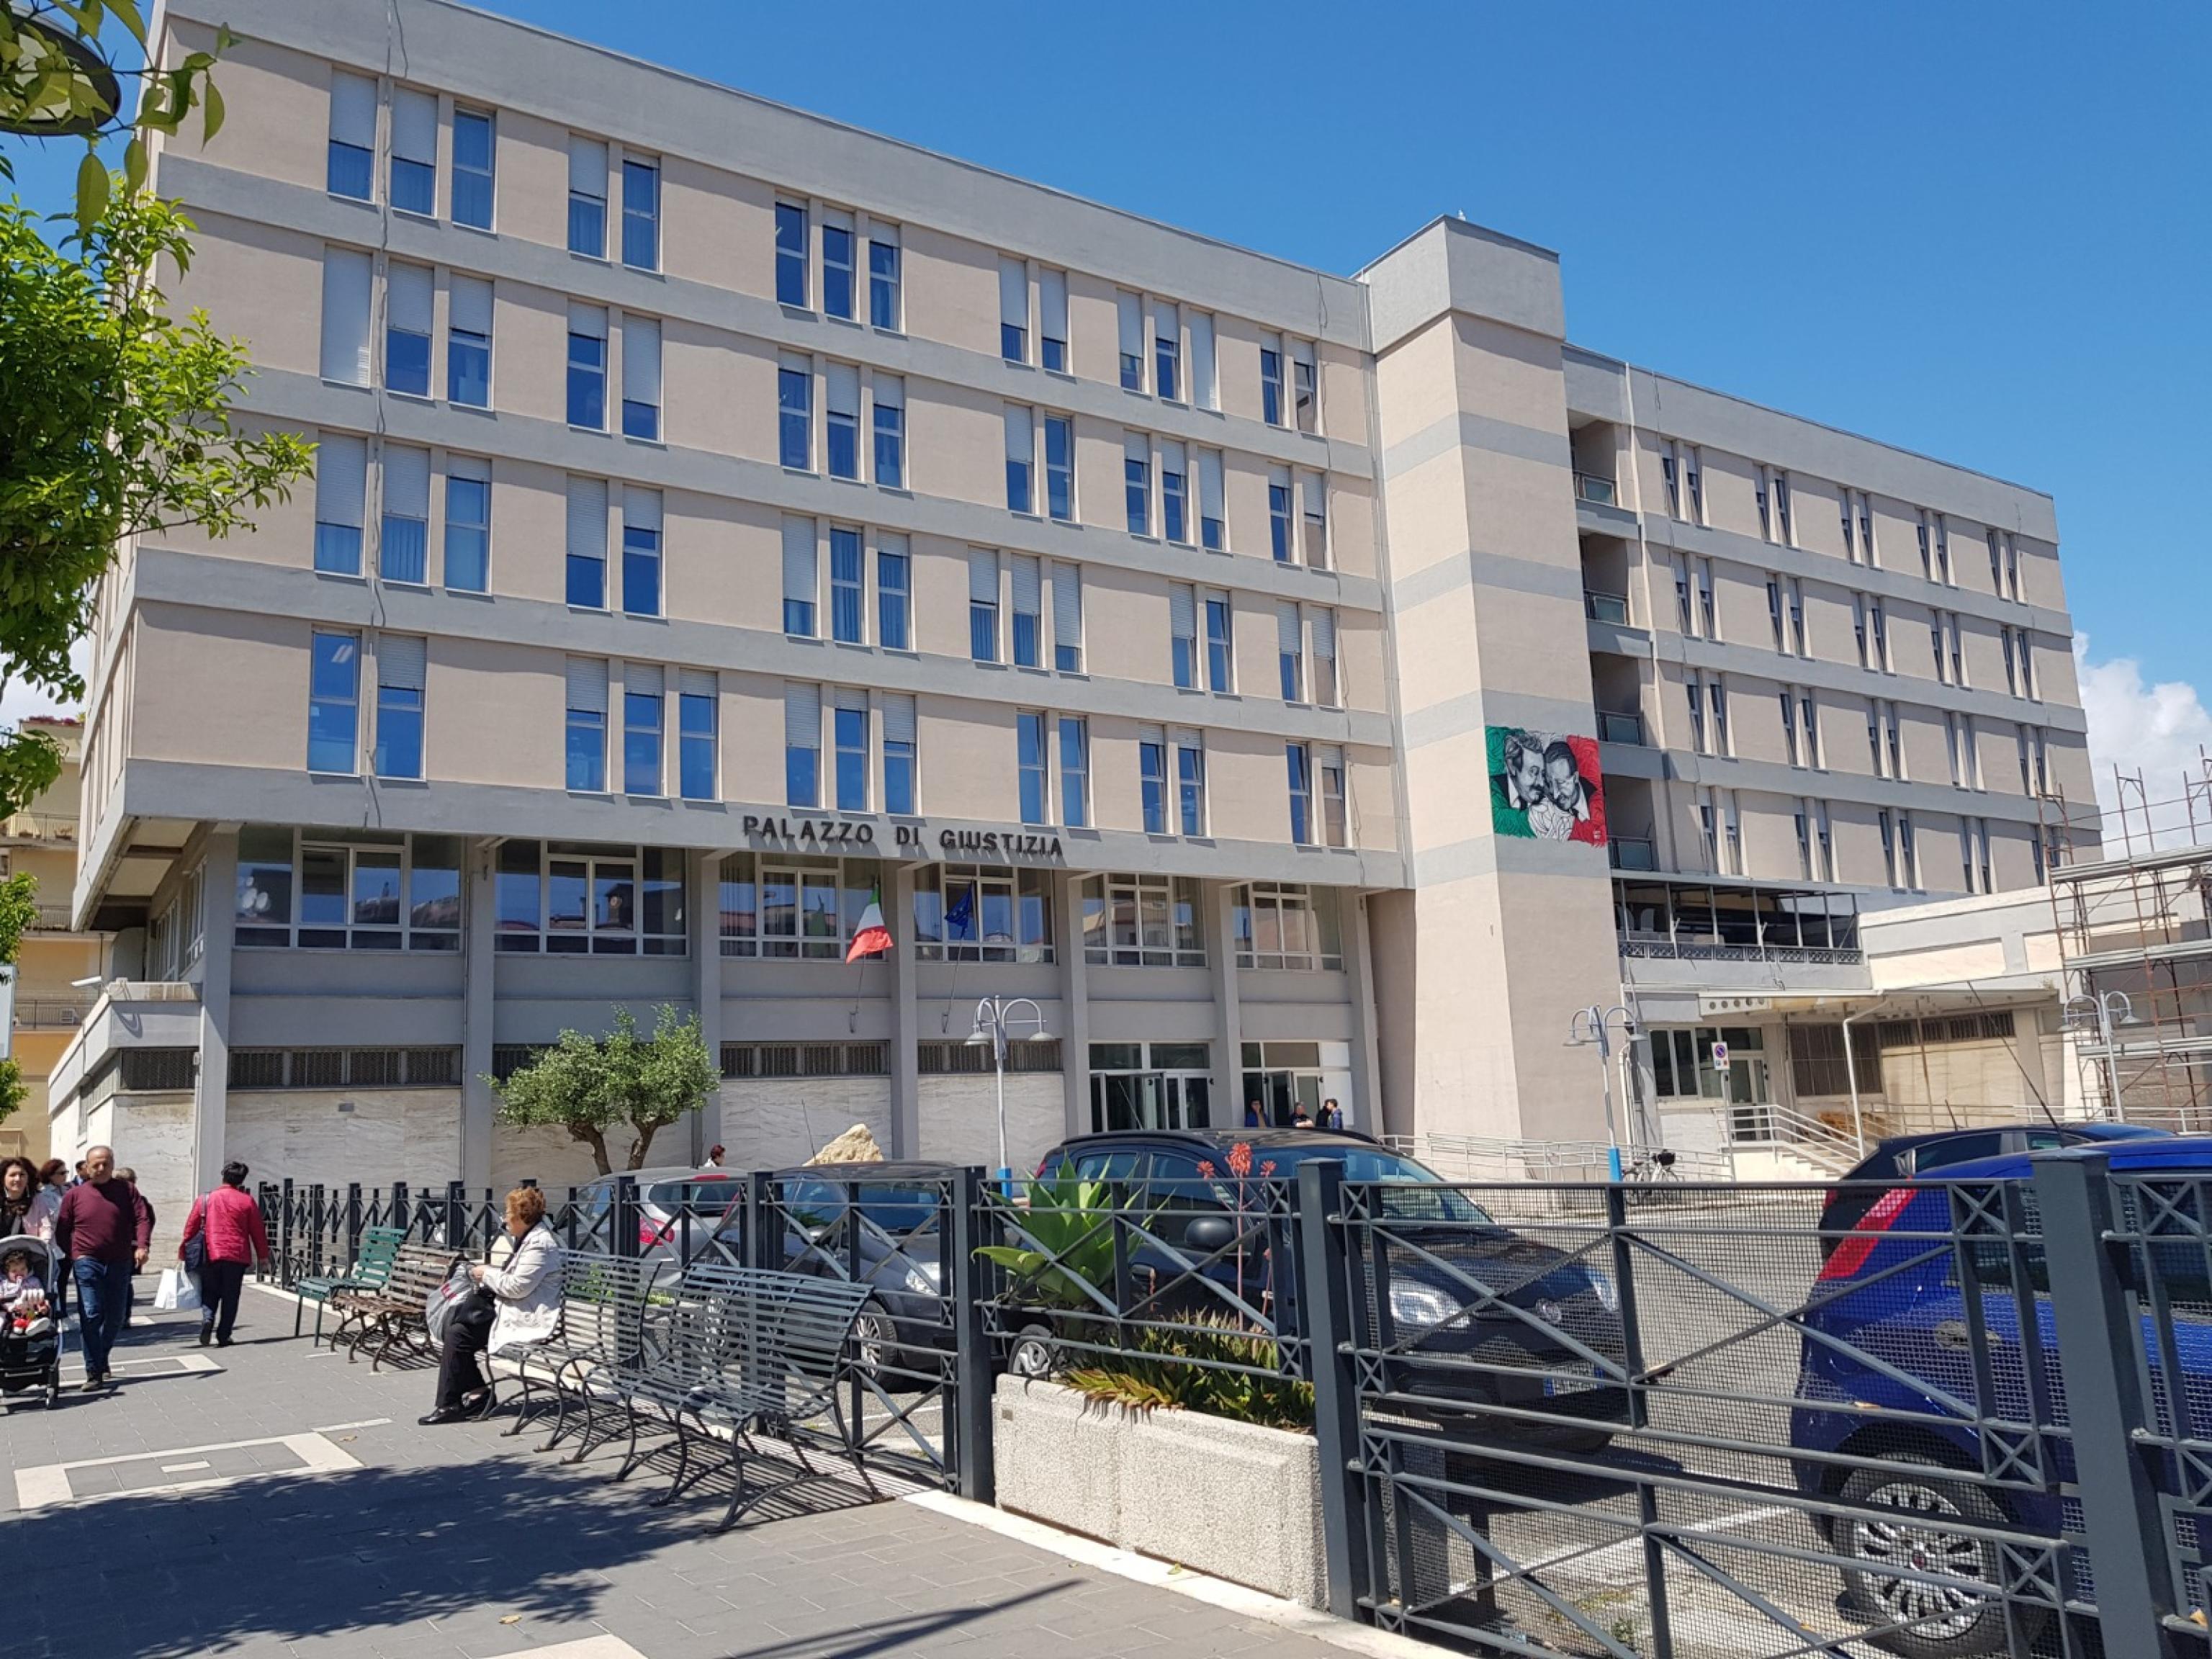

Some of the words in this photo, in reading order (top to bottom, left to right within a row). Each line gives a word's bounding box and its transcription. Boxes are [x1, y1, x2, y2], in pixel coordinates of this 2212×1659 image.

[743, 815, 873, 843] PALAZZO
[896, 826, 920, 845] DI
[939, 829, 1064, 856] GIUSTIZIA
